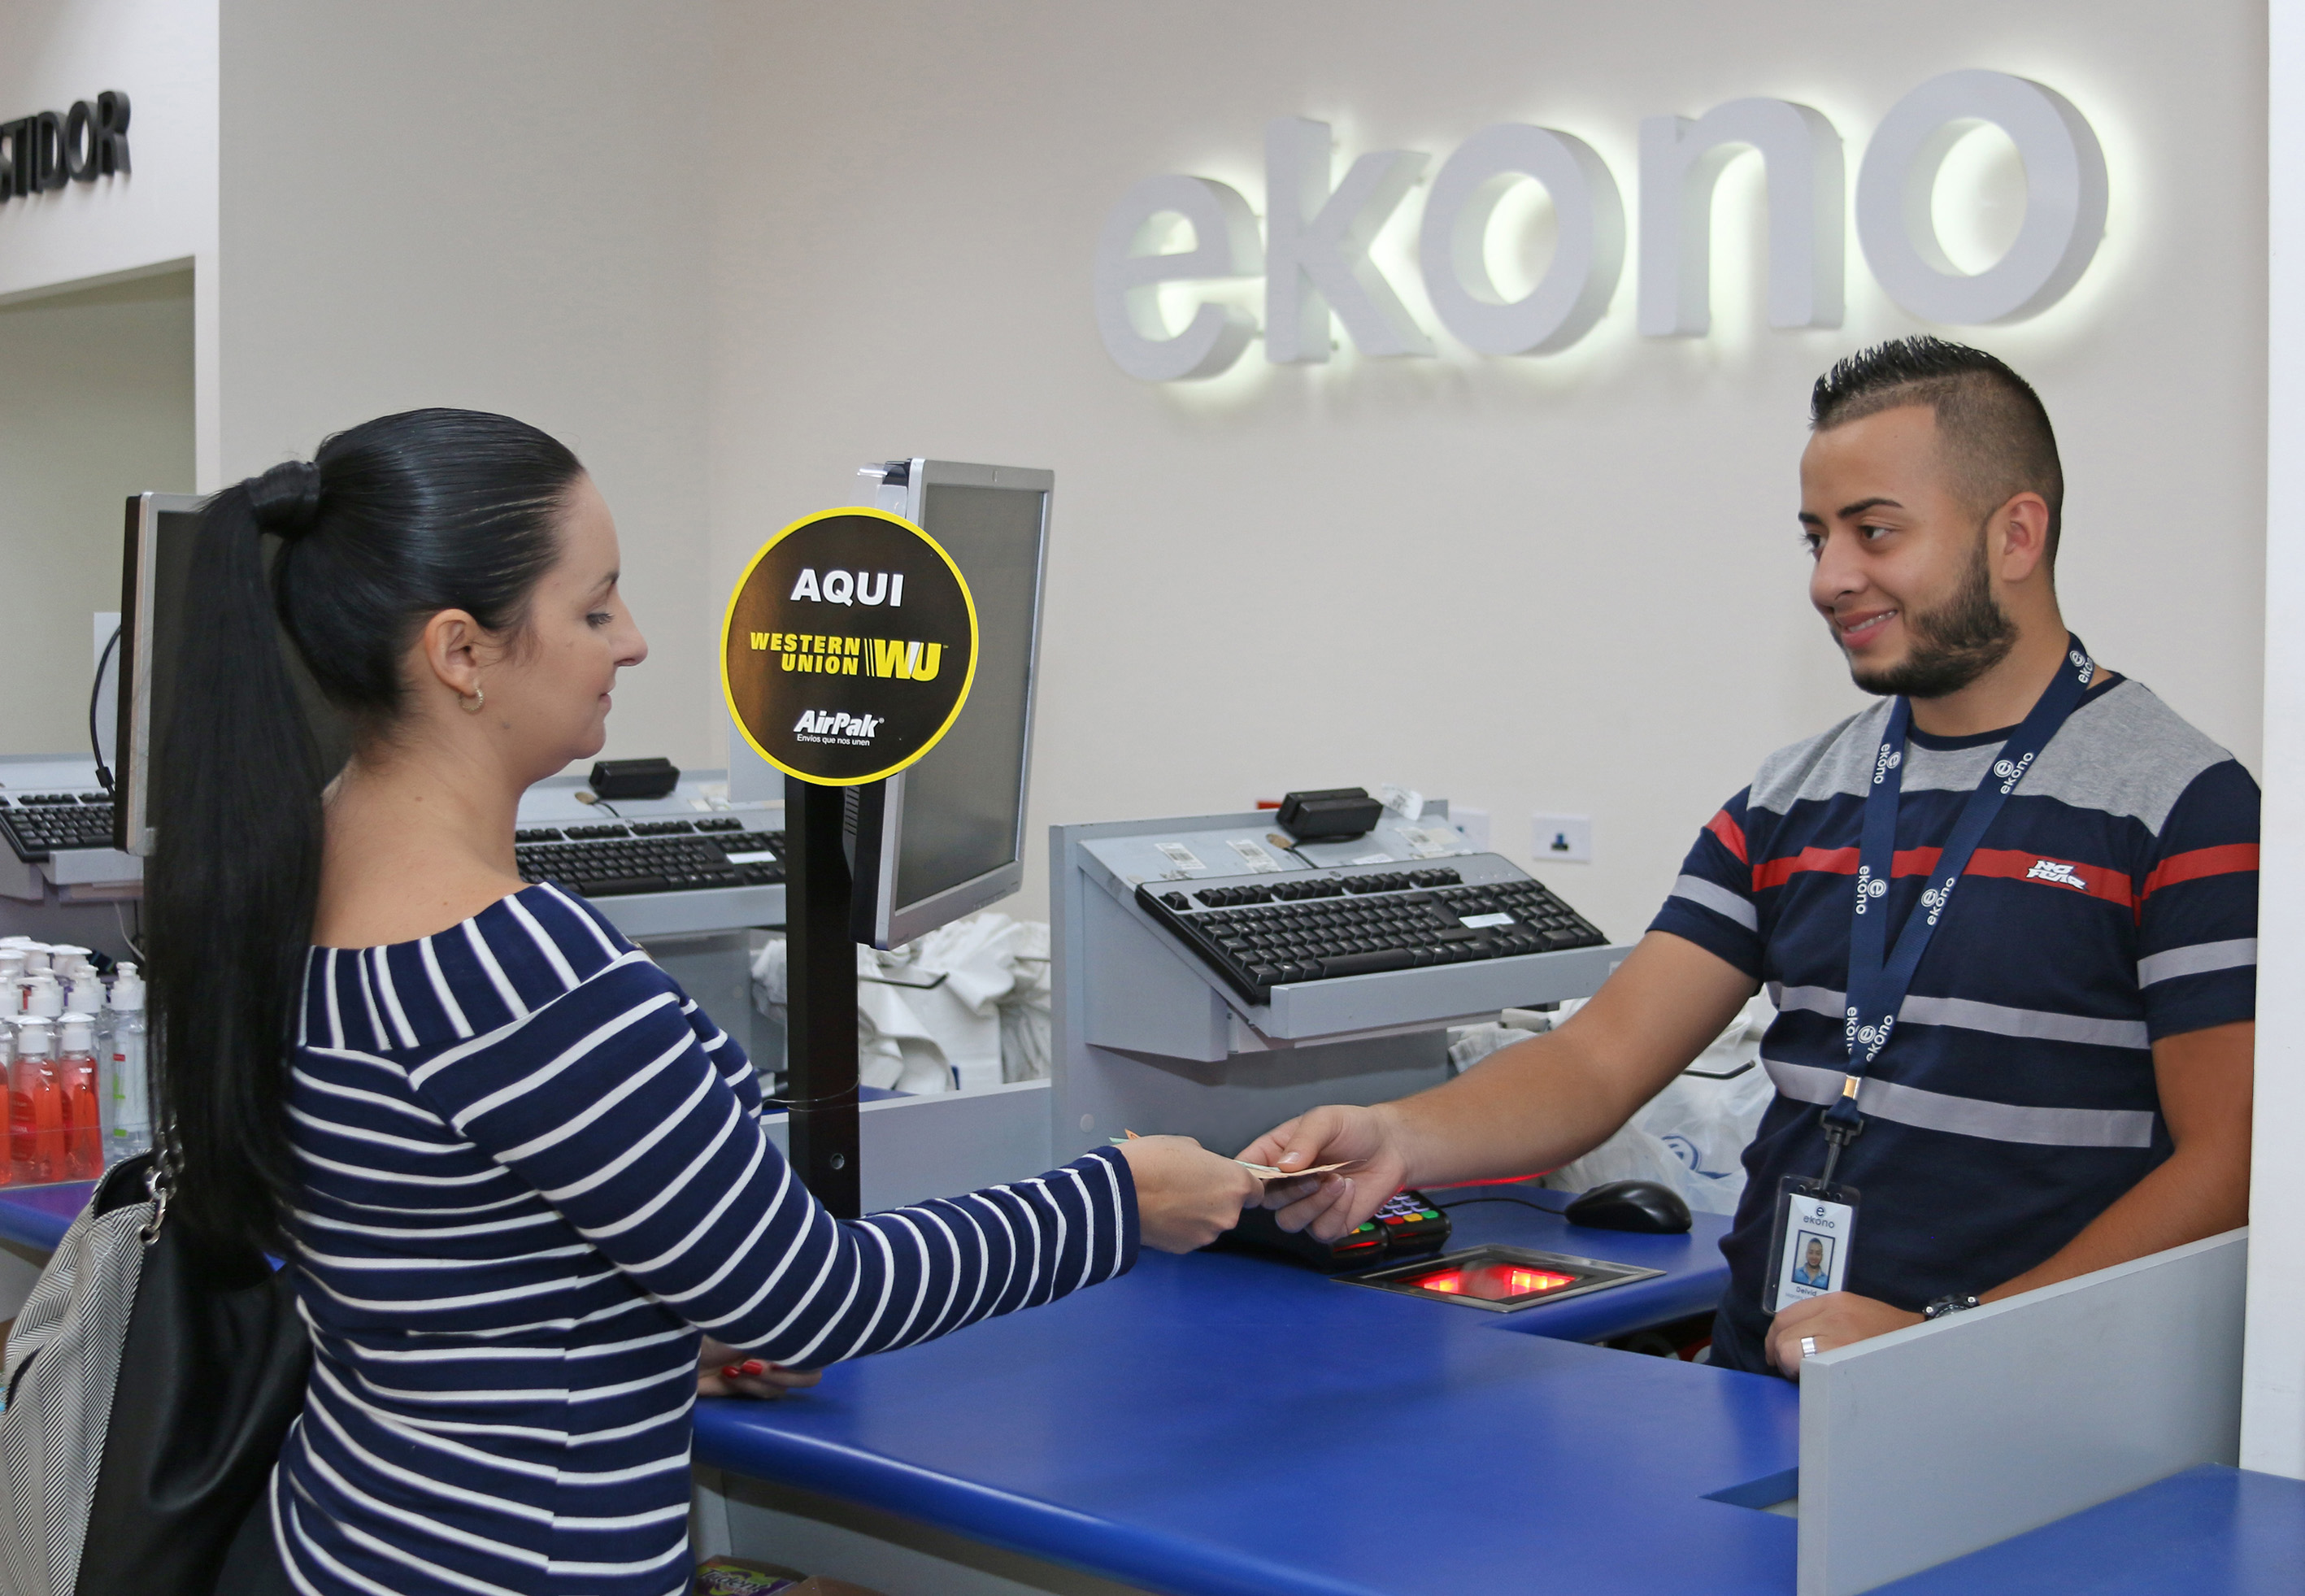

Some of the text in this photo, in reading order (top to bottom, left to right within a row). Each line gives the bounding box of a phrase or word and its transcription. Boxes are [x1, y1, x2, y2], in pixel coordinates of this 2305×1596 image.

[1094, 68, 2109, 382] ekono
[790, 568, 904, 607] AQUI
[750, 632, 942, 682] WESTERN WU
[781, 653, 859, 676] UNION
[793, 710, 878, 737] AirPak
[822, 737, 836, 745] que
[1873, 743, 1890, 785] ekono
[2000, 752, 2033, 794] ekono
[2033, 859, 2074, 875] NO
[1855, 865, 1871, 915] ekono
[1926, 877, 1955, 925] ekono
[1803, 1215, 1835, 1229] ekono
